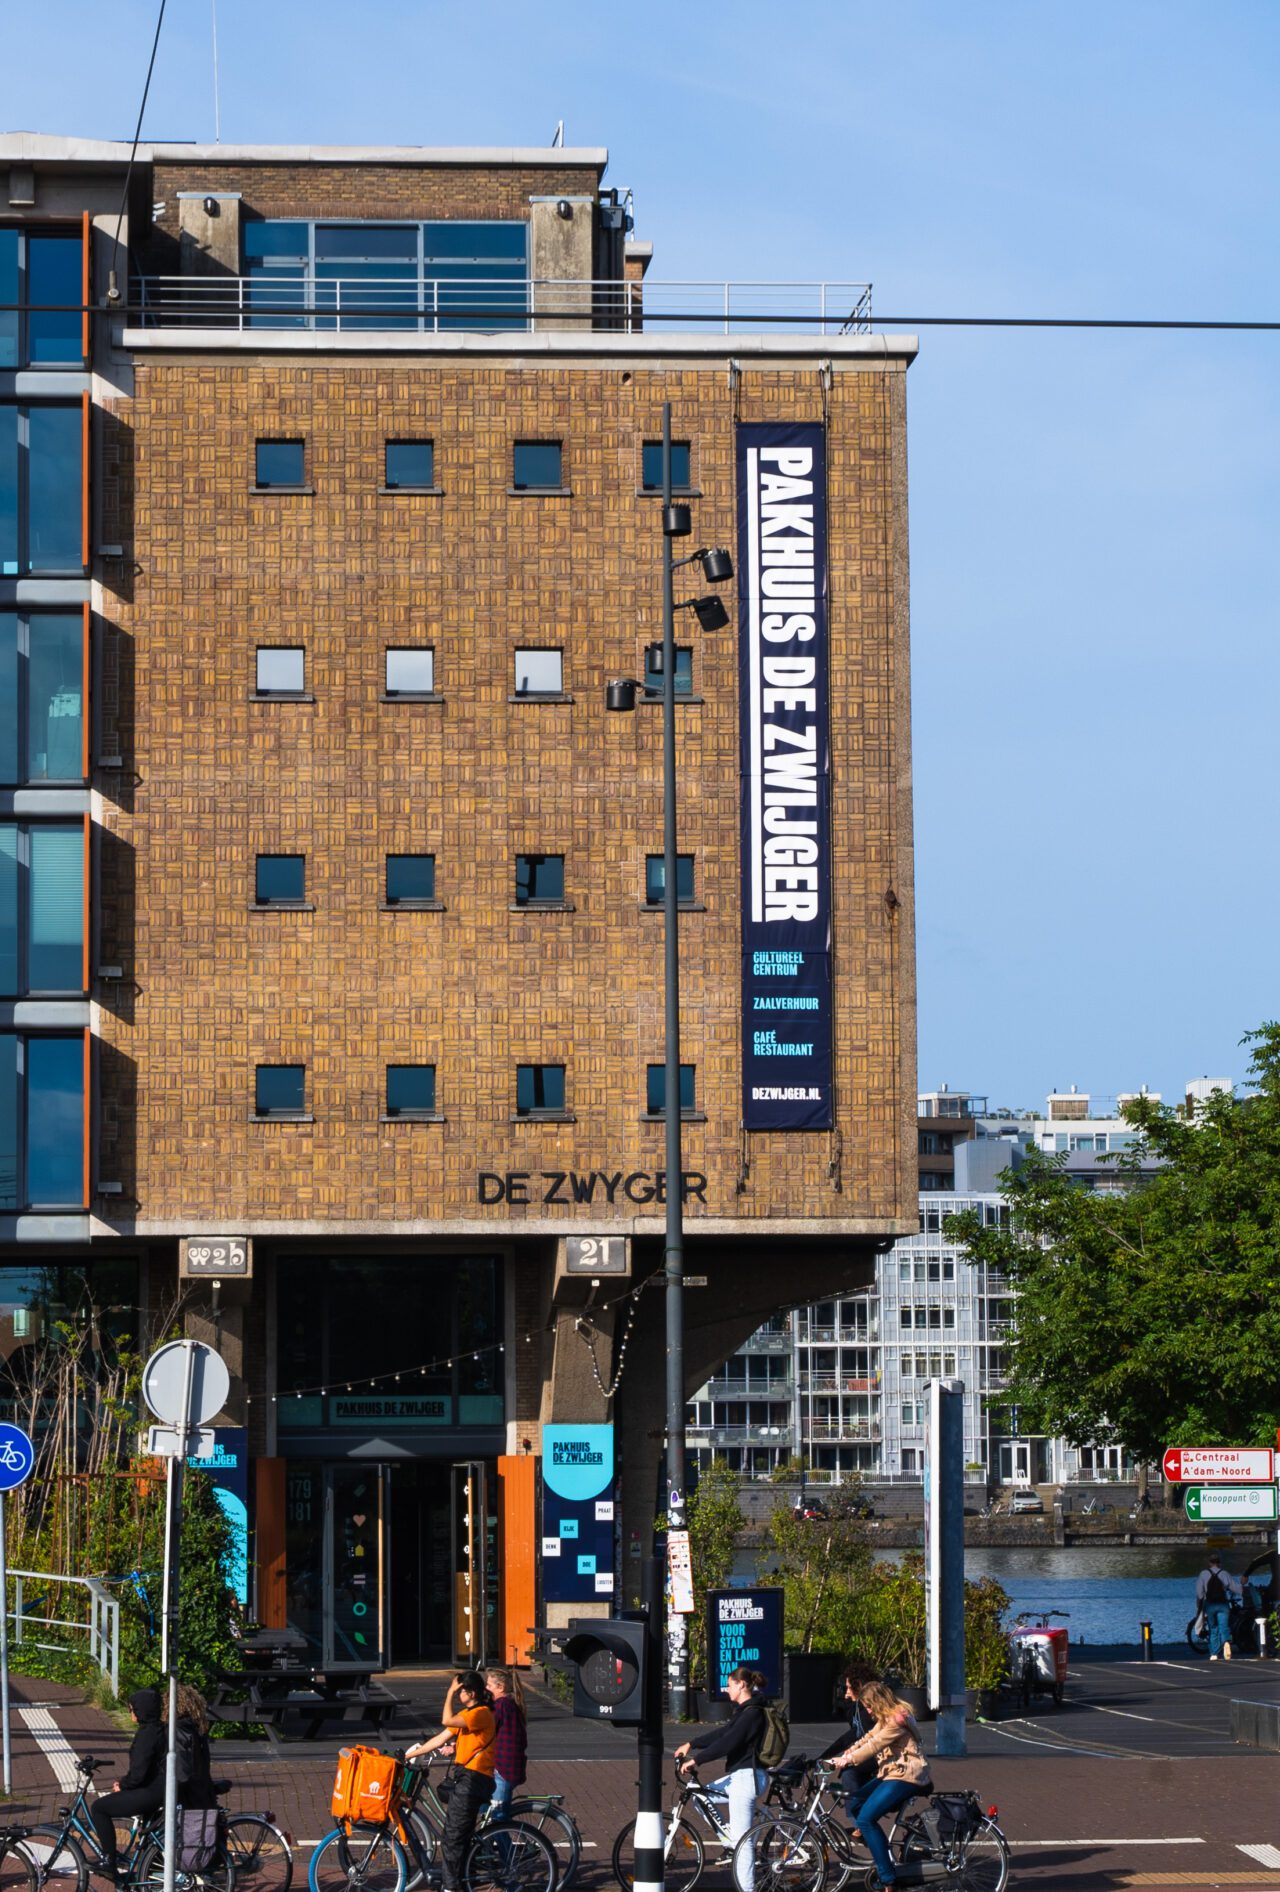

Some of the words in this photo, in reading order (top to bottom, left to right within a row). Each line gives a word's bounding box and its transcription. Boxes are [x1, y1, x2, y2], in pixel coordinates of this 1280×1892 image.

[760, 447, 816, 643] PAKHUIS
[763, 656, 816, 713] DE
[763, 723, 819, 922] ZWIJGER
[753, 951, 805, 963] CULTUREEL
[753, 964, 798, 976] CENTRUM
[753, 997, 819, 1010] ZAALVERHUUR
[753, 1029, 777, 1043] CAFÉ
[753, 1043, 814, 1056] RESTAURANT
[752, 1087, 821, 1100] DEZWIJGER.NL
[478, 1172, 531, 1205] DE
[578, 1238, 610, 1266] 21
[336, 1402, 383, 1414] PAKHUIS
[384, 1402, 398, 1414] DE
[400, 1401, 444, 1414] ZWIJGER
[553, 1441, 591, 1453] PAKHUIS
[199, 1454, 237, 1466] ZWIJGER
[553, 1452, 564, 1463] DE
[566, 1452, 603, 1463] ZWIJGER
[1195, 1452, 1240, 1462] Centraal
[1183, 1466, 1251, 1476] A'dam-Noord
[288, 1479, 312, 1499] 179
[1202, 1494, 1247, 1504] Knooppunt
[288, 1502, 312, 1521] 181
[718, 1598, 753, 1610] PAKHUIS
[719, 1608, 729, 1619] DE
[731, 1607, 764, 1619] ZWIJGER
[720, 1623, 746, 1637] VOOR
[720, 1636, 744, 1649] STAD
[720, 1649, 732, 1662] EN
[735, 1648, 760, 1661] LAND
[599, 1705, 613, 1714] 991
